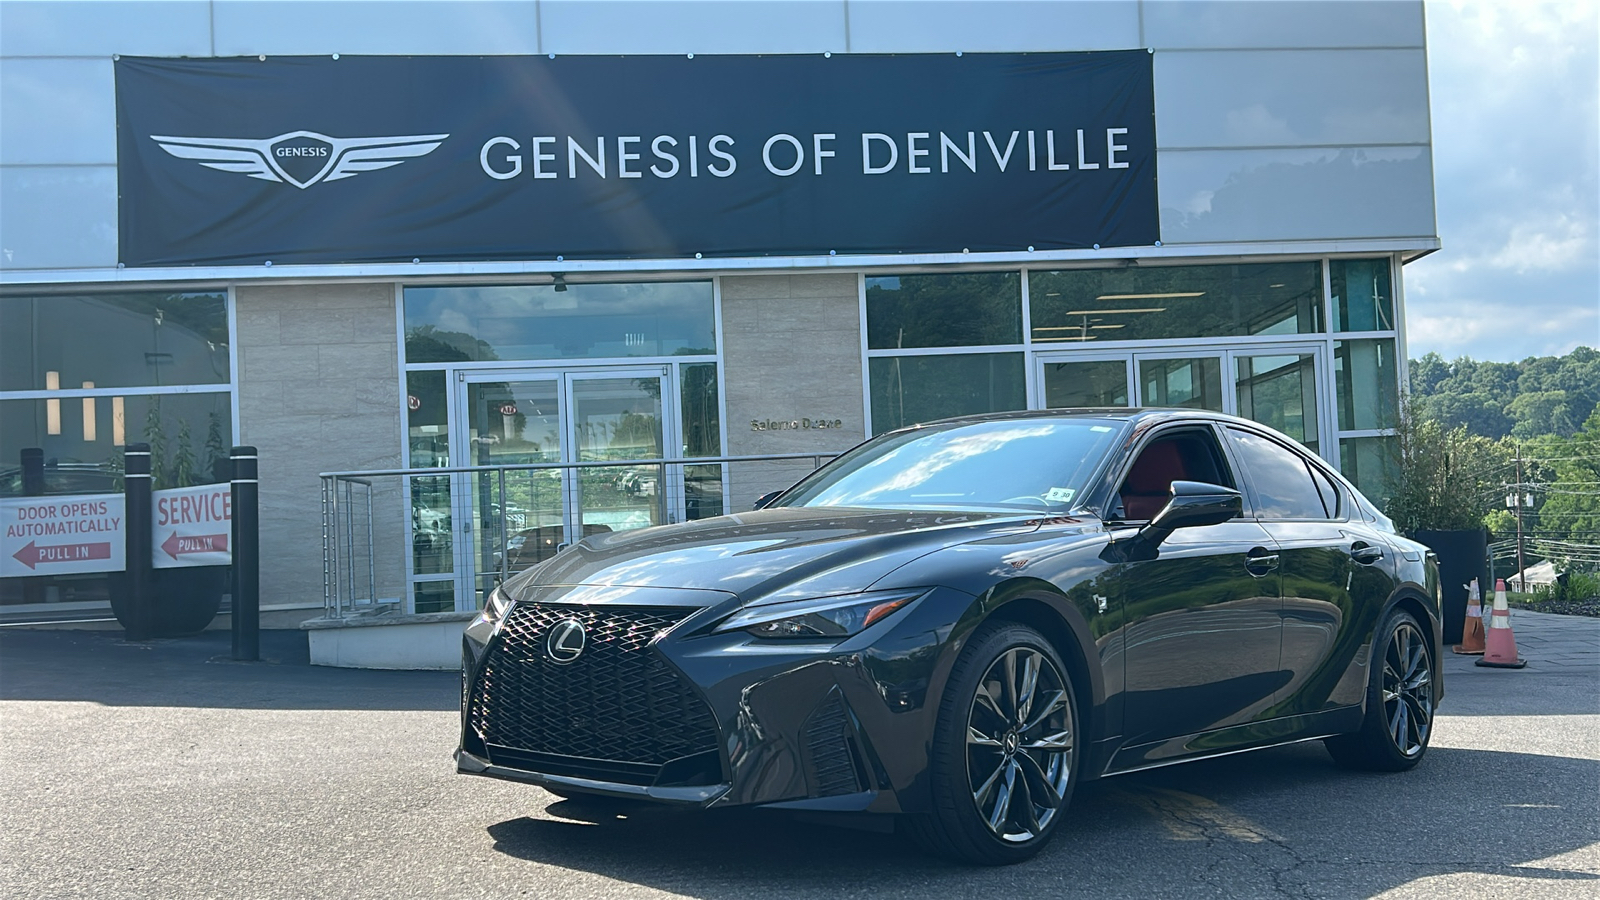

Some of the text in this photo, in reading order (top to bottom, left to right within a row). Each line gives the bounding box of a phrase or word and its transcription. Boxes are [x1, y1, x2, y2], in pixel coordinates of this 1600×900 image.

[275, 146, 327, 158] GENESIS
[480, 127, 1131, 180] GENESIS OF DENVILLE
[750, 418, 798, 432] Salerno
[18, 501, 108, 521] DOOR OPENS
[158, 492, 231, 526] SERVICE
[7, 518, 120, 537] AUTOMATICALLY
[178, 537, 215, 552] PULL IN
[39, 546, 90, 561] PULL IN
